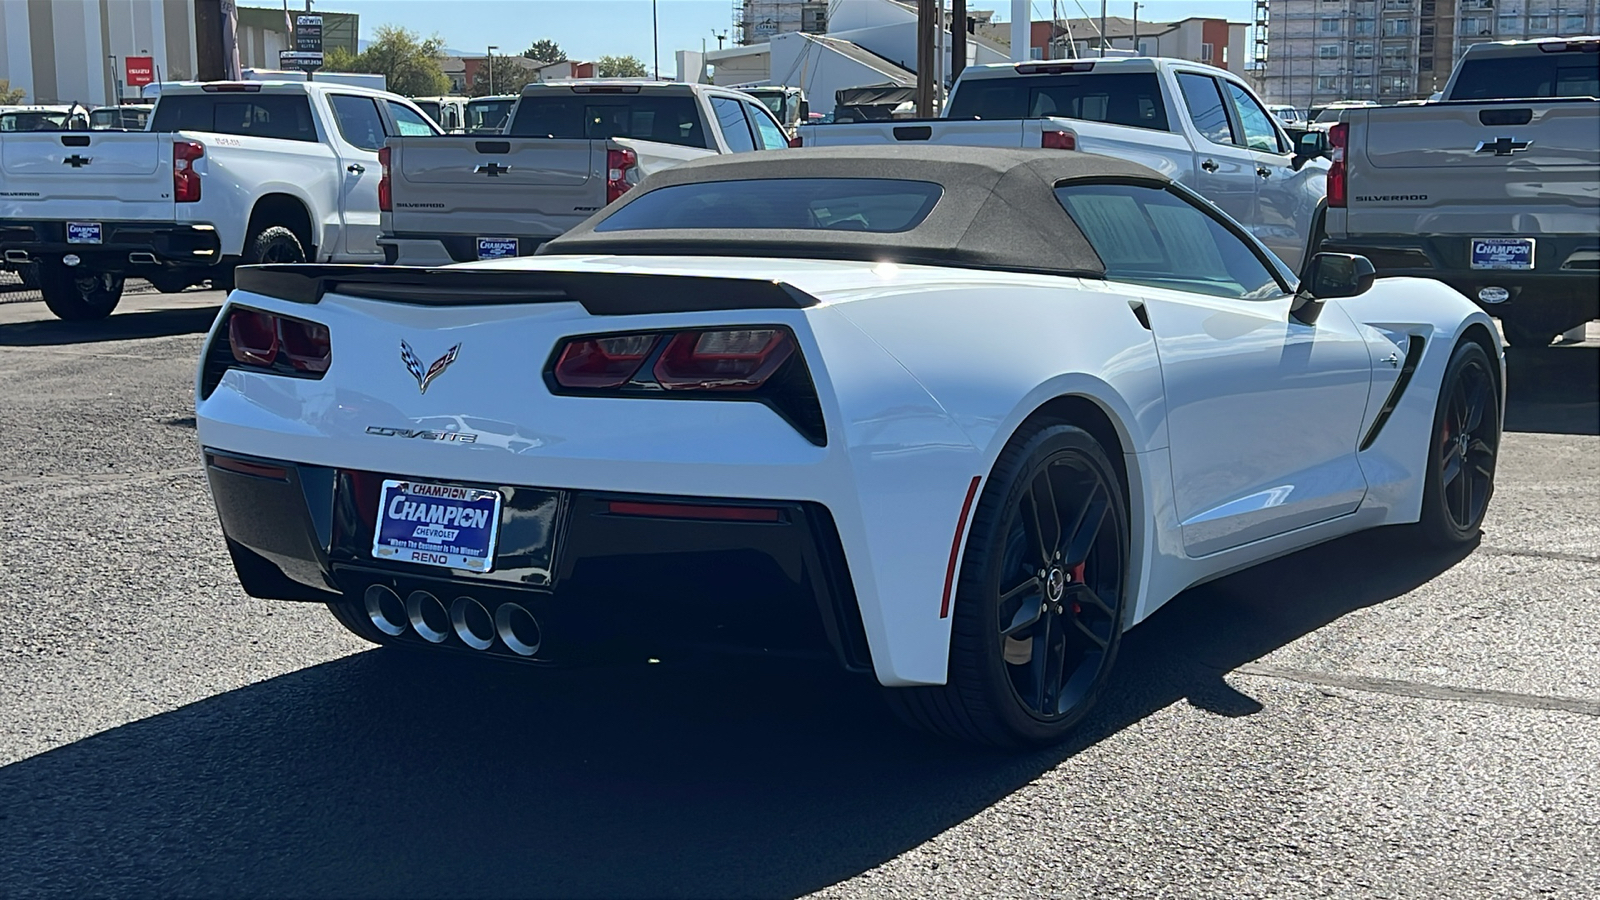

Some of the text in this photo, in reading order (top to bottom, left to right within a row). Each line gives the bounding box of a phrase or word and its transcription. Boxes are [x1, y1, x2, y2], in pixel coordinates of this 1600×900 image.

[70, 225, 100, 233] CHAMPION
[480, 241, 516, 250] CHAMPION
[1476, 243, 1530, 254] CHAMPION
[365, 426, 478, 444] CORVETTE
[412, 484, 467, 500] CHAMPION
[388, 495, 489, 530] CHAMPION
[416, 528, 456, 538] CHEVROLET
[408, 540, 418, 548] The
[418, 542, 443, 552] Customer
[450, 546, 459, 554] The
[412, 551, 448, 564] RENO
